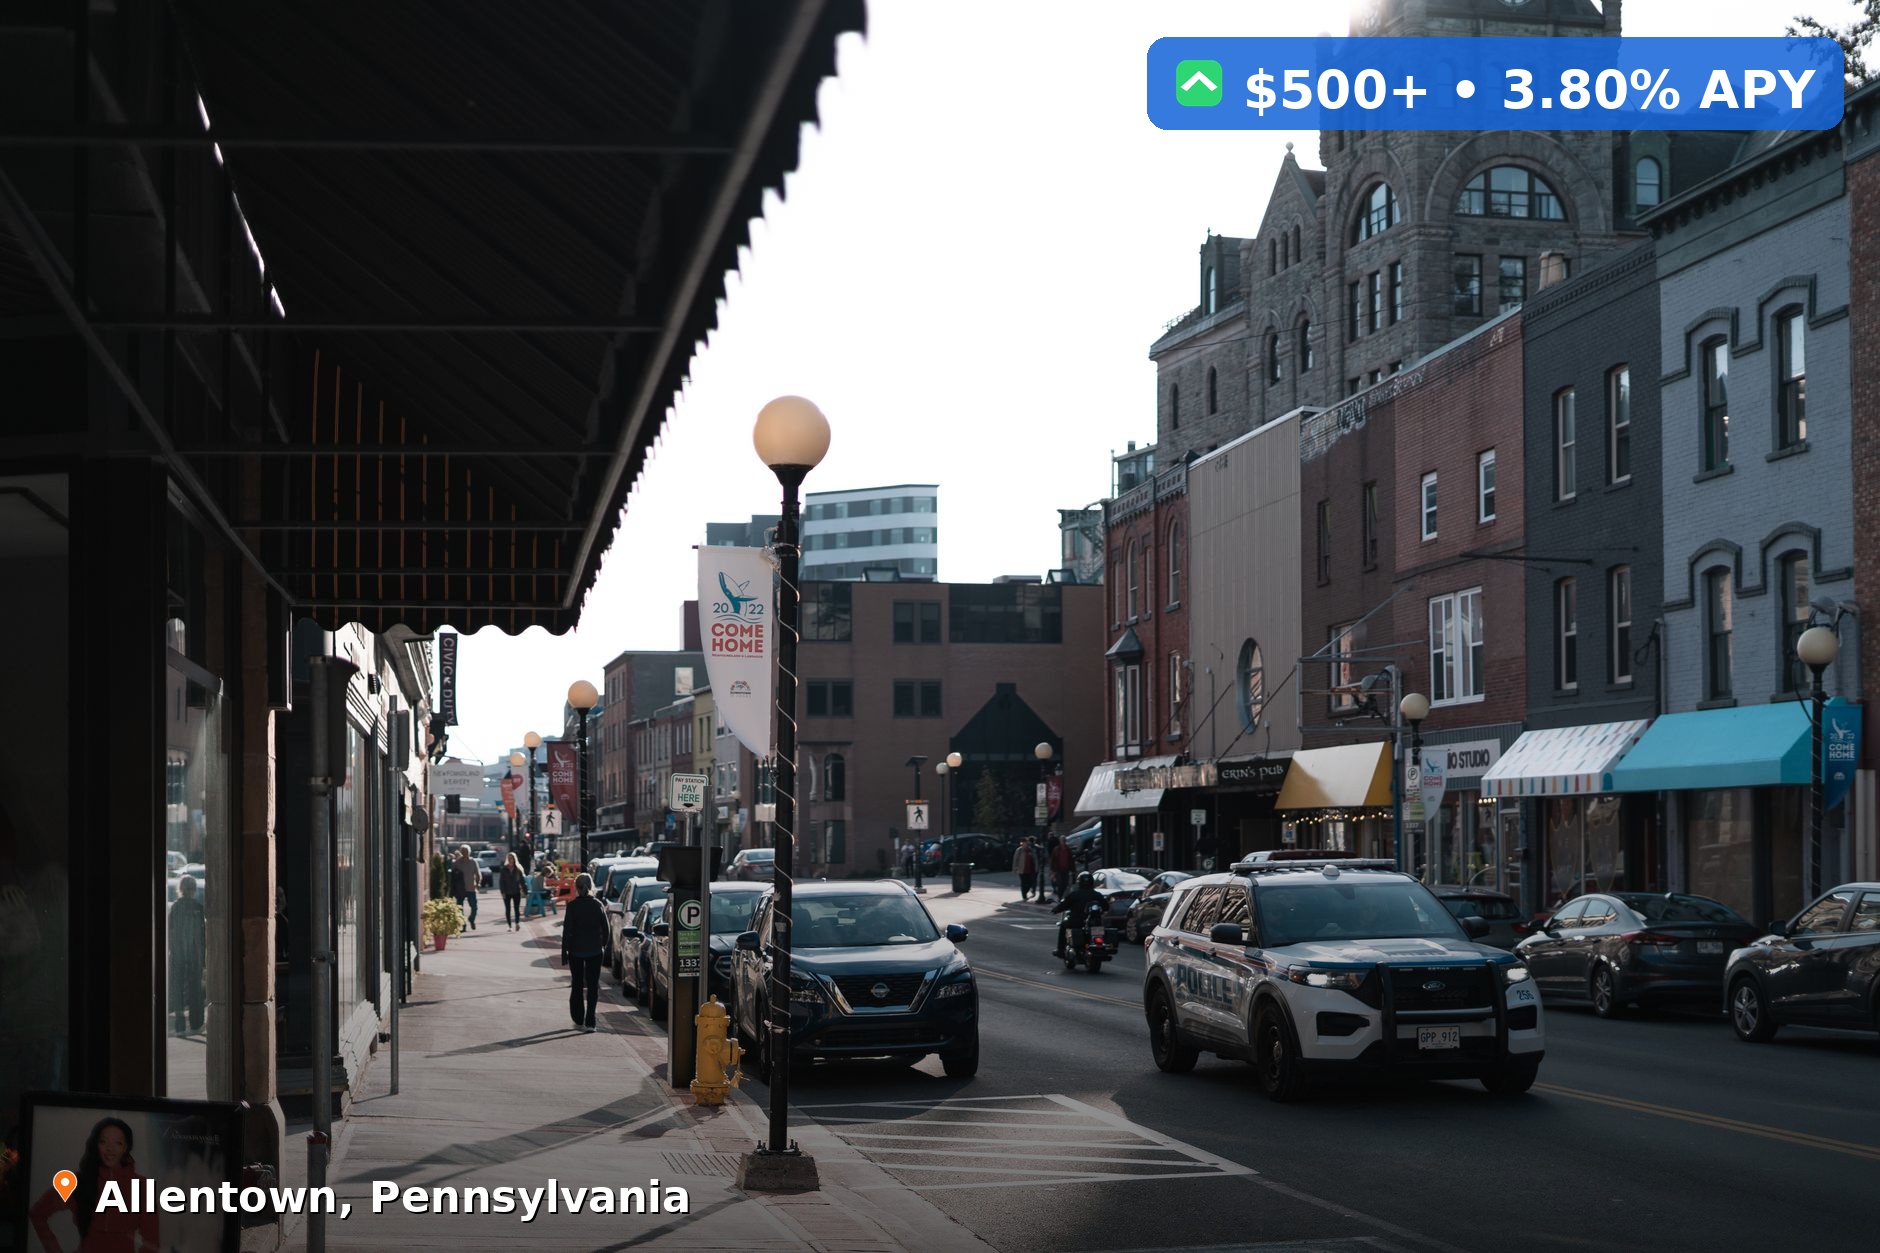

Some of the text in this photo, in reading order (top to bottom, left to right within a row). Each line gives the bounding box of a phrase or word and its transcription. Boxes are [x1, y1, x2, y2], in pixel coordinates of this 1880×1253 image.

[711, 622, 764, 638] COME
[711, 638, 764, 653] HOME
[442, 637, 454, 676] CIVIC
[1829, 743, 1855, 751] COME
[1459, 749, 1489, 769] STUDIO
[1829, 751, 1855, 759] HOME
[1222, 764, 1283, 781] ERIN'S PUB
[682, 784, 697, 793] PAY
[677, 793, 700, 802] HERE
[687, 906, 700, 924] P
[1177, 964, 1233, 1004] POLICE
[1516, 990, 1534, 1000] 256
[1421, 1032, 1457, 1042] GPP 912
